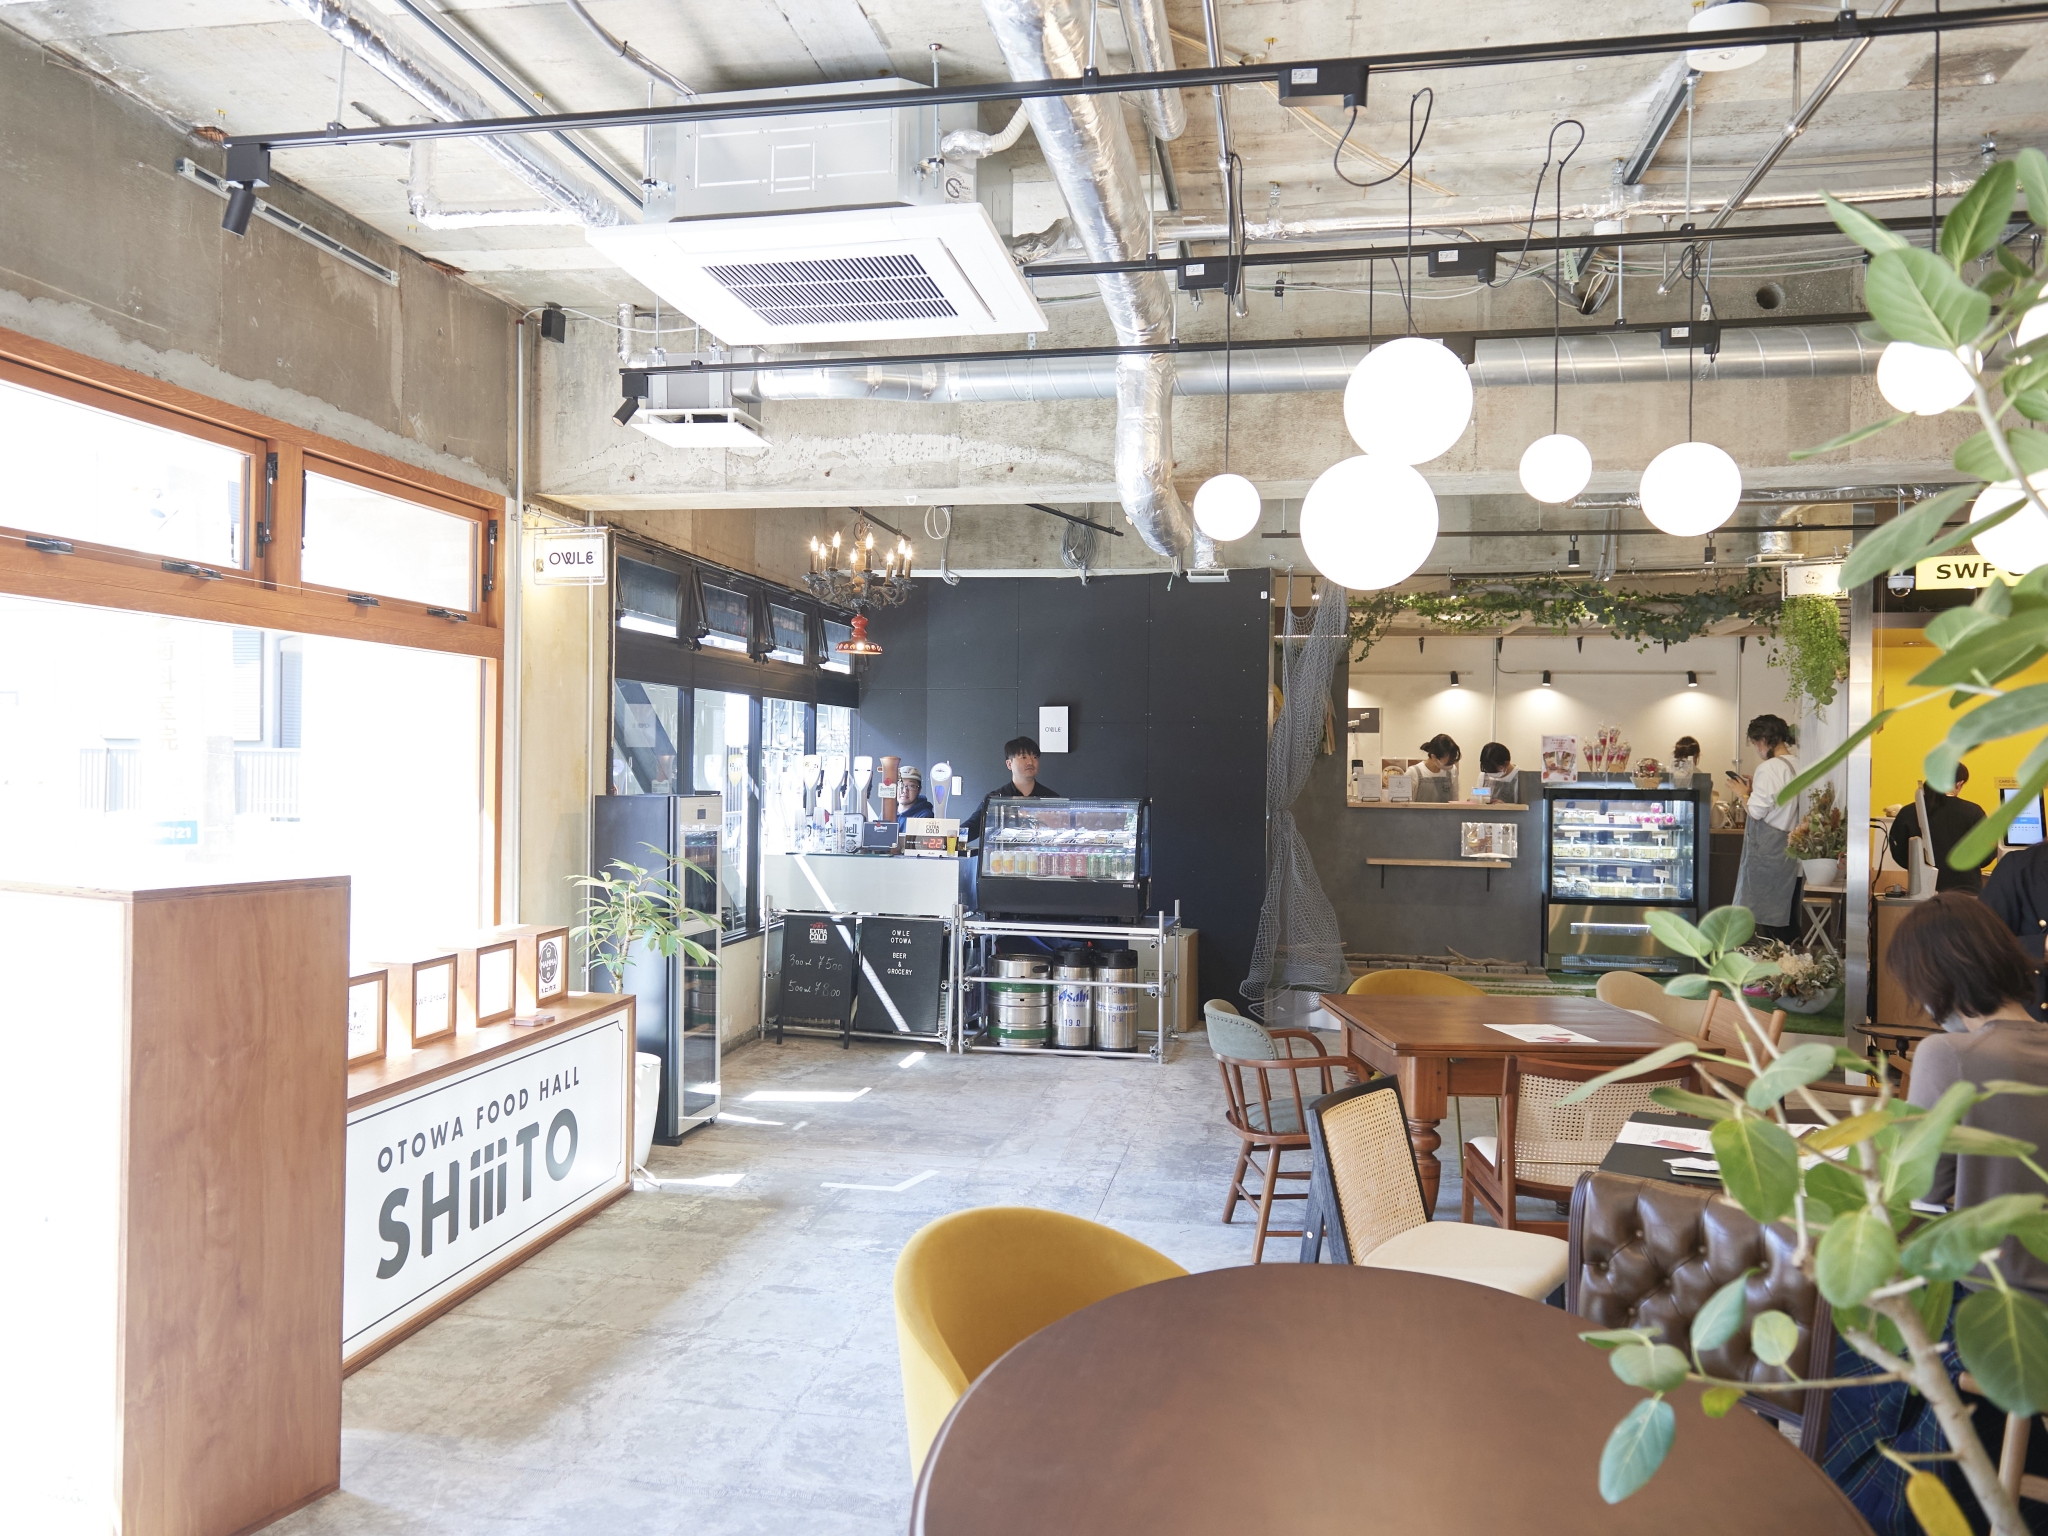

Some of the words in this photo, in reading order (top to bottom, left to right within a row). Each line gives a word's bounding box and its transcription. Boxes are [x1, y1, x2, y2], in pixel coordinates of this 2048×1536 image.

[891, 929, 911, 937] OWLE
[890, 937, 912, 945] OTOWA
[886, 968, 913, 976] GROCERY
[1058, 988, 1090, 1003] Asahi
[377, 1116, 464, 1173] OTOWA
[476, 1088, 529, 1130] FOOD
[539, 1066, 580, 1101] HALL
